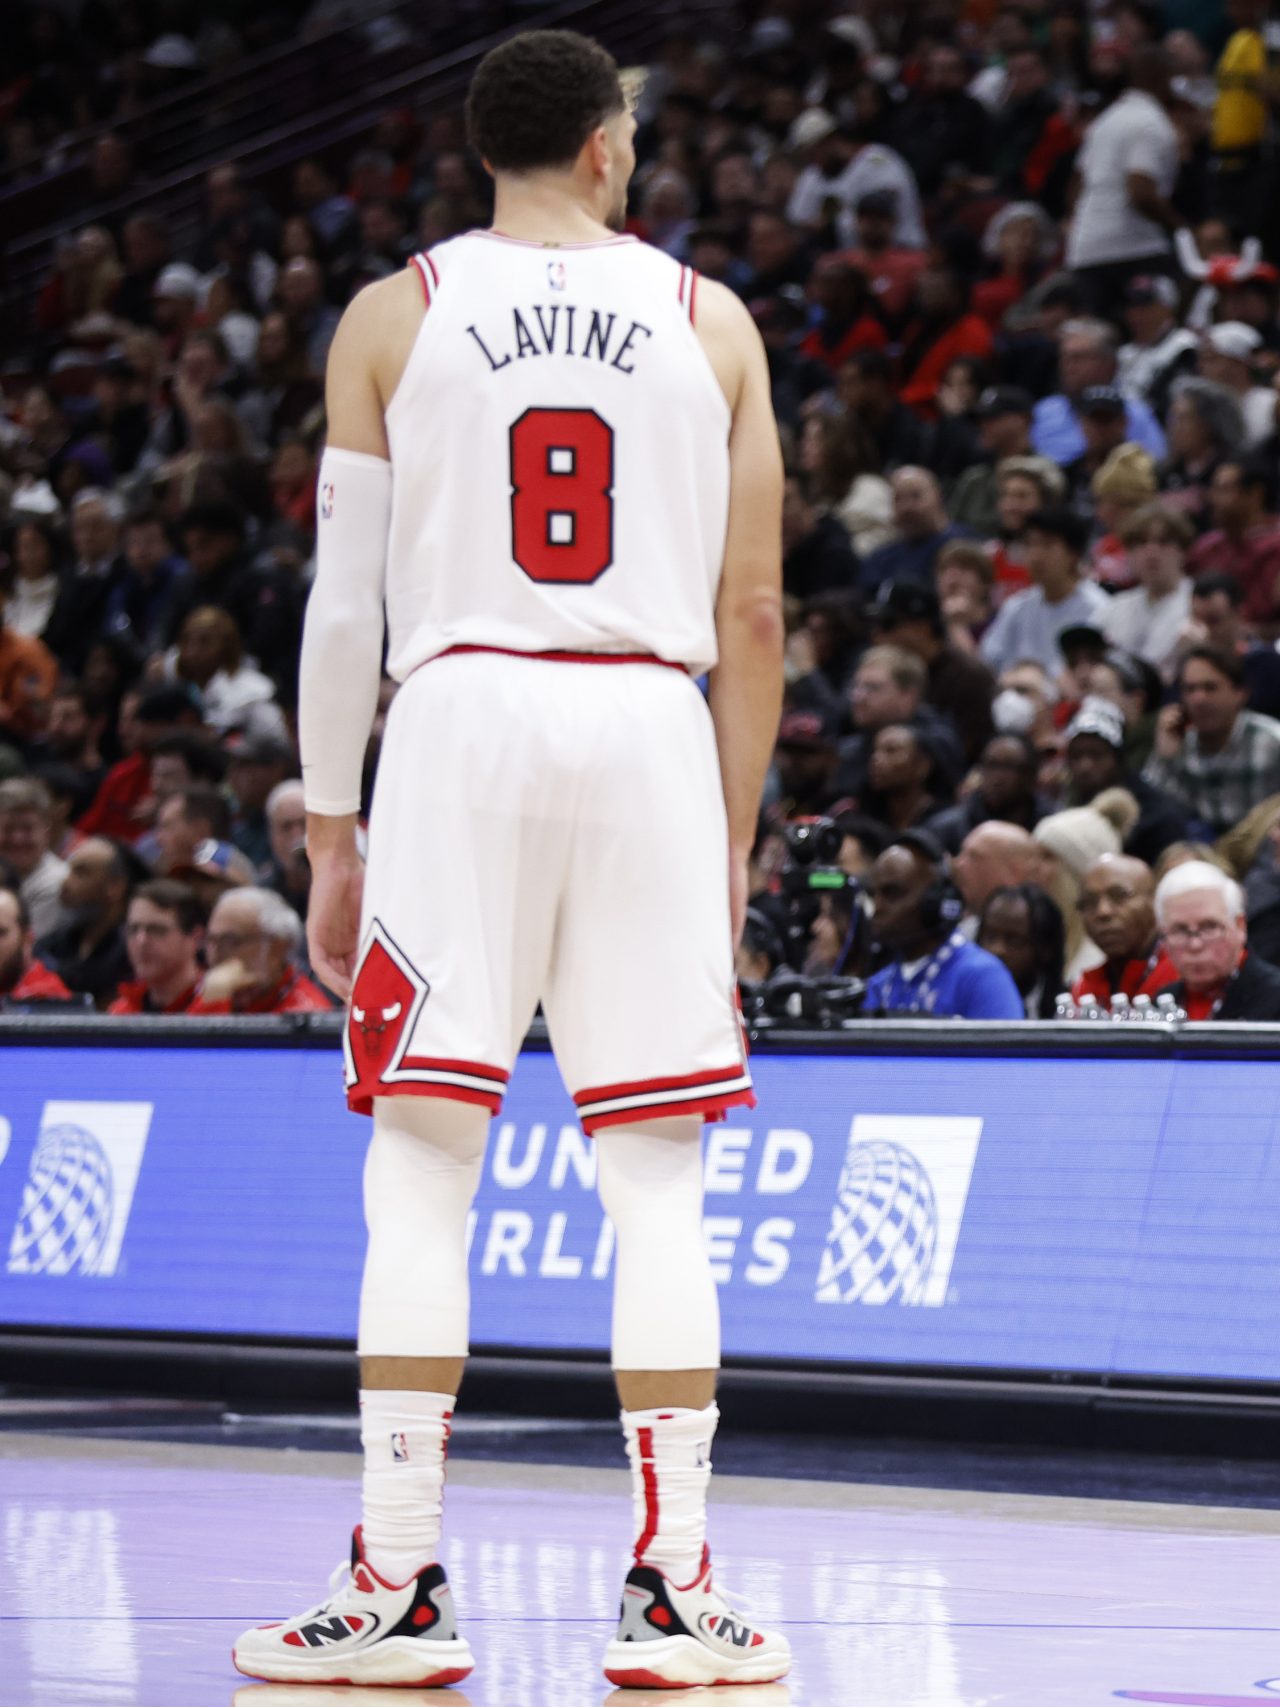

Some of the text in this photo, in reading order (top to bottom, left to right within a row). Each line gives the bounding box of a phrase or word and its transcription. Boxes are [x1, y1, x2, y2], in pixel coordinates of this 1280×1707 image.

[466, 304, 652, 375] LAVINE
[509, 407, 615, 585] 8
[492, 1122, 814, 1195] UNED
[465, 1209, 796, 1286] RLIES
